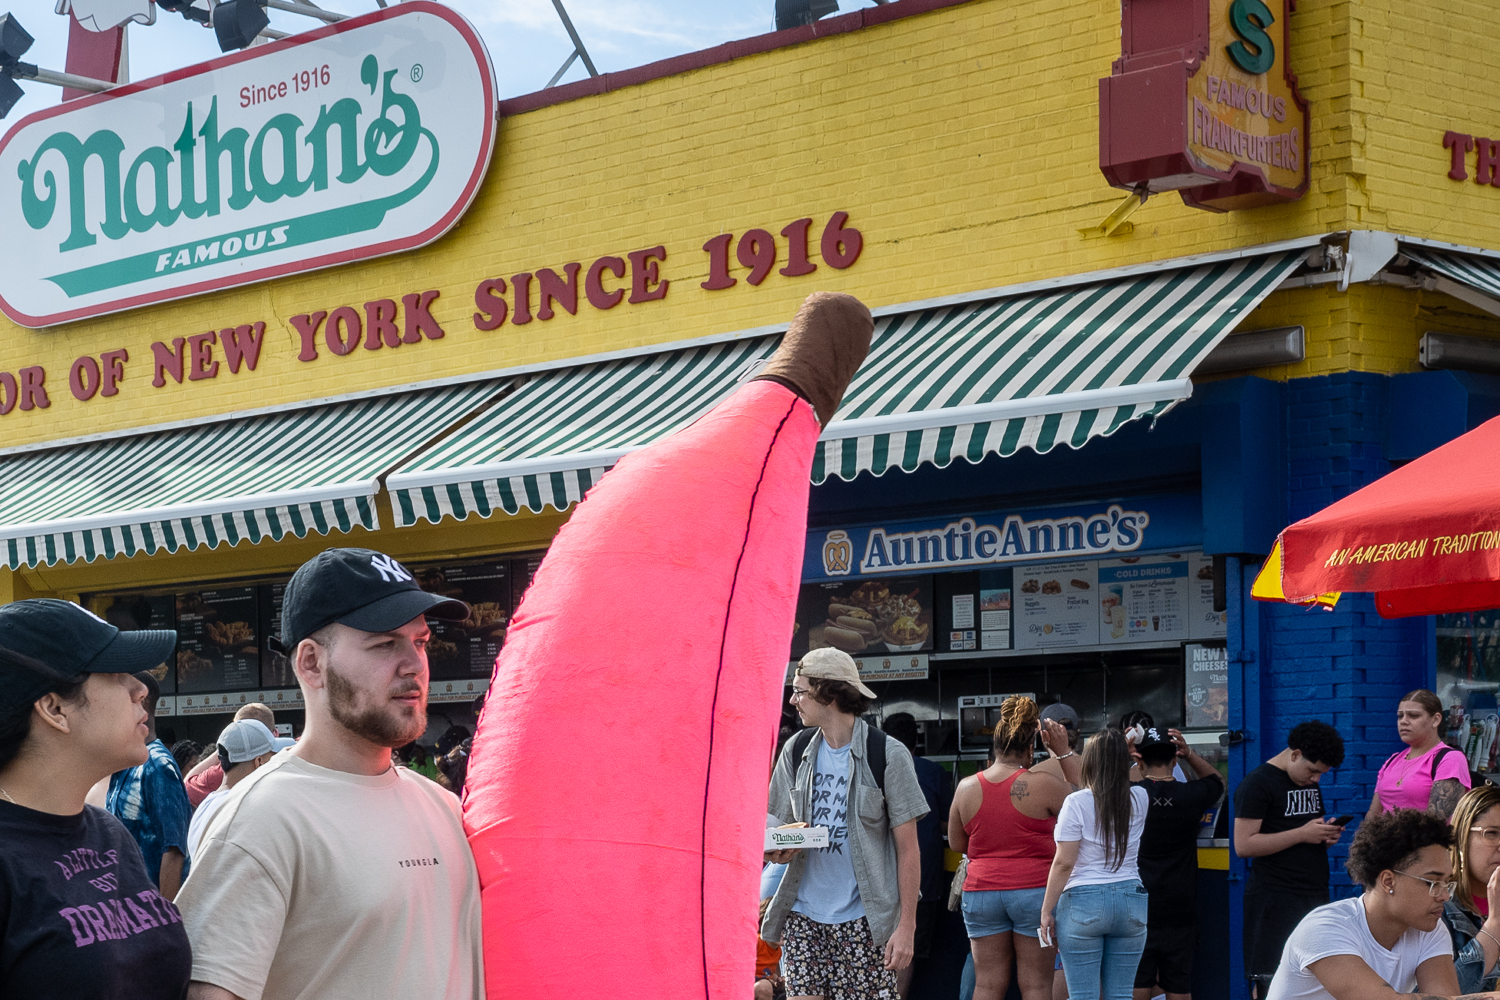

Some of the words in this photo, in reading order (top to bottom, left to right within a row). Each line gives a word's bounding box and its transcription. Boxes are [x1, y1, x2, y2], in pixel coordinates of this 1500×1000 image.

[1226, 0, 1275, 74] S
[238, 73, 287, 110] Since
[291, 64, 331, 97] 1916
[1207, 75, 1286, 122] FAMOUS
[18, 54, 424, 253] Nathan's
[1193, 95, 1300, 172] FRANKFURTERS
[155, 225, 290, 273] FAMOUS
[68, 348, 129, 401] OF
[150, 321, 267, 388] NEW
[289, 290, 446, 362] YORK
[472, 246, 670, 332] SINCE
[700, 211, 864, 291] 1916
[1324, 548, 1350, 569] AN
[1348, 537, 1429, 565] AMERICAN
[1432, 530, 1500, 557] TRADITION
[1116, 570, 1139, 578] COLD
[1140, 566, 1172, 577] DRINKS
[1193, 648, 1220, 661] NEW
[1284, 788, 1321, 817] NIKE
[54, 860, 74, 881] A
[62, 847, 119, 874] LITTLE
[88, 872, 118, 893] BIT
